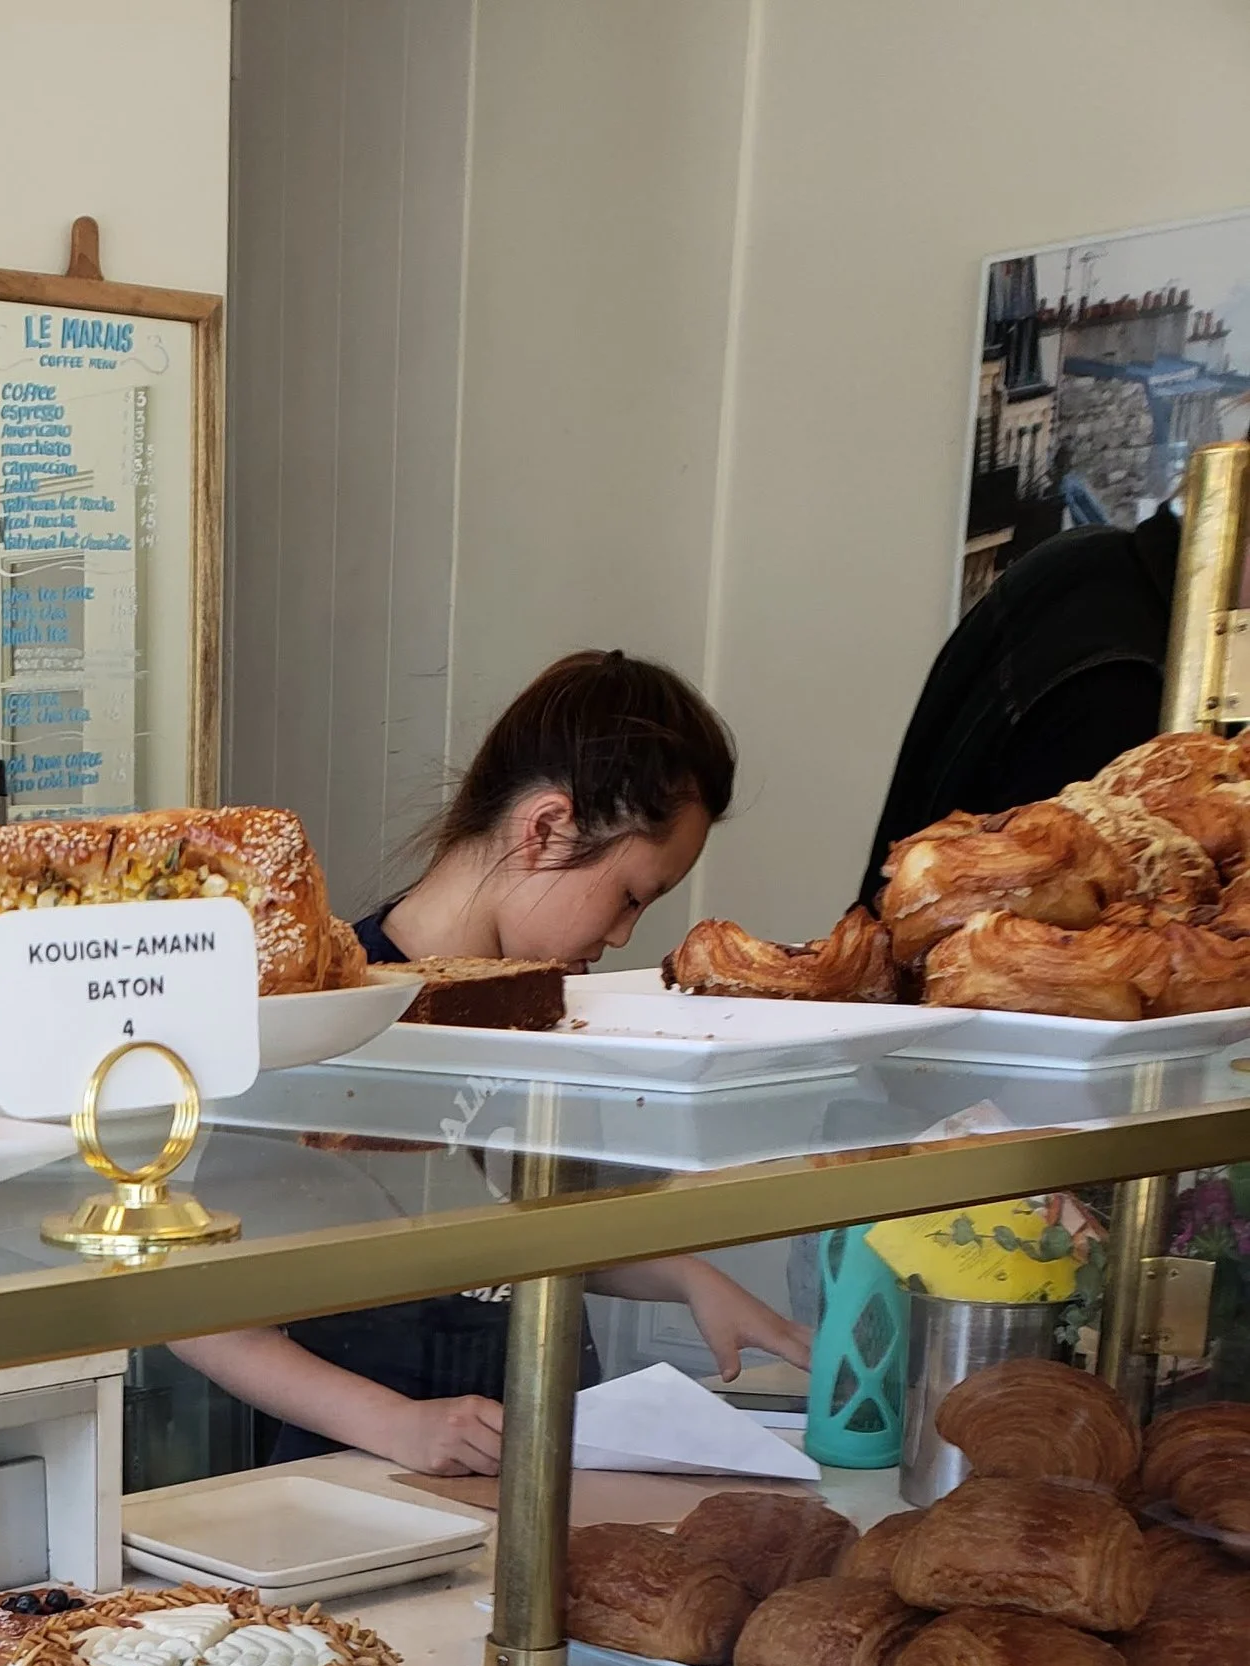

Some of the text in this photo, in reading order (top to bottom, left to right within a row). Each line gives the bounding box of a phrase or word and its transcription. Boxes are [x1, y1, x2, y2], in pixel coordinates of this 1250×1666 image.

[25, 314, 134, 353] LE MARAIS
[39, 354, 118, 370] COFFEE MENU
[29, 931, 216, 965] KOUIGN-AMANN
[88, 976, 165, 1001] BATON
[123, 1019, 135, 1038] 4
